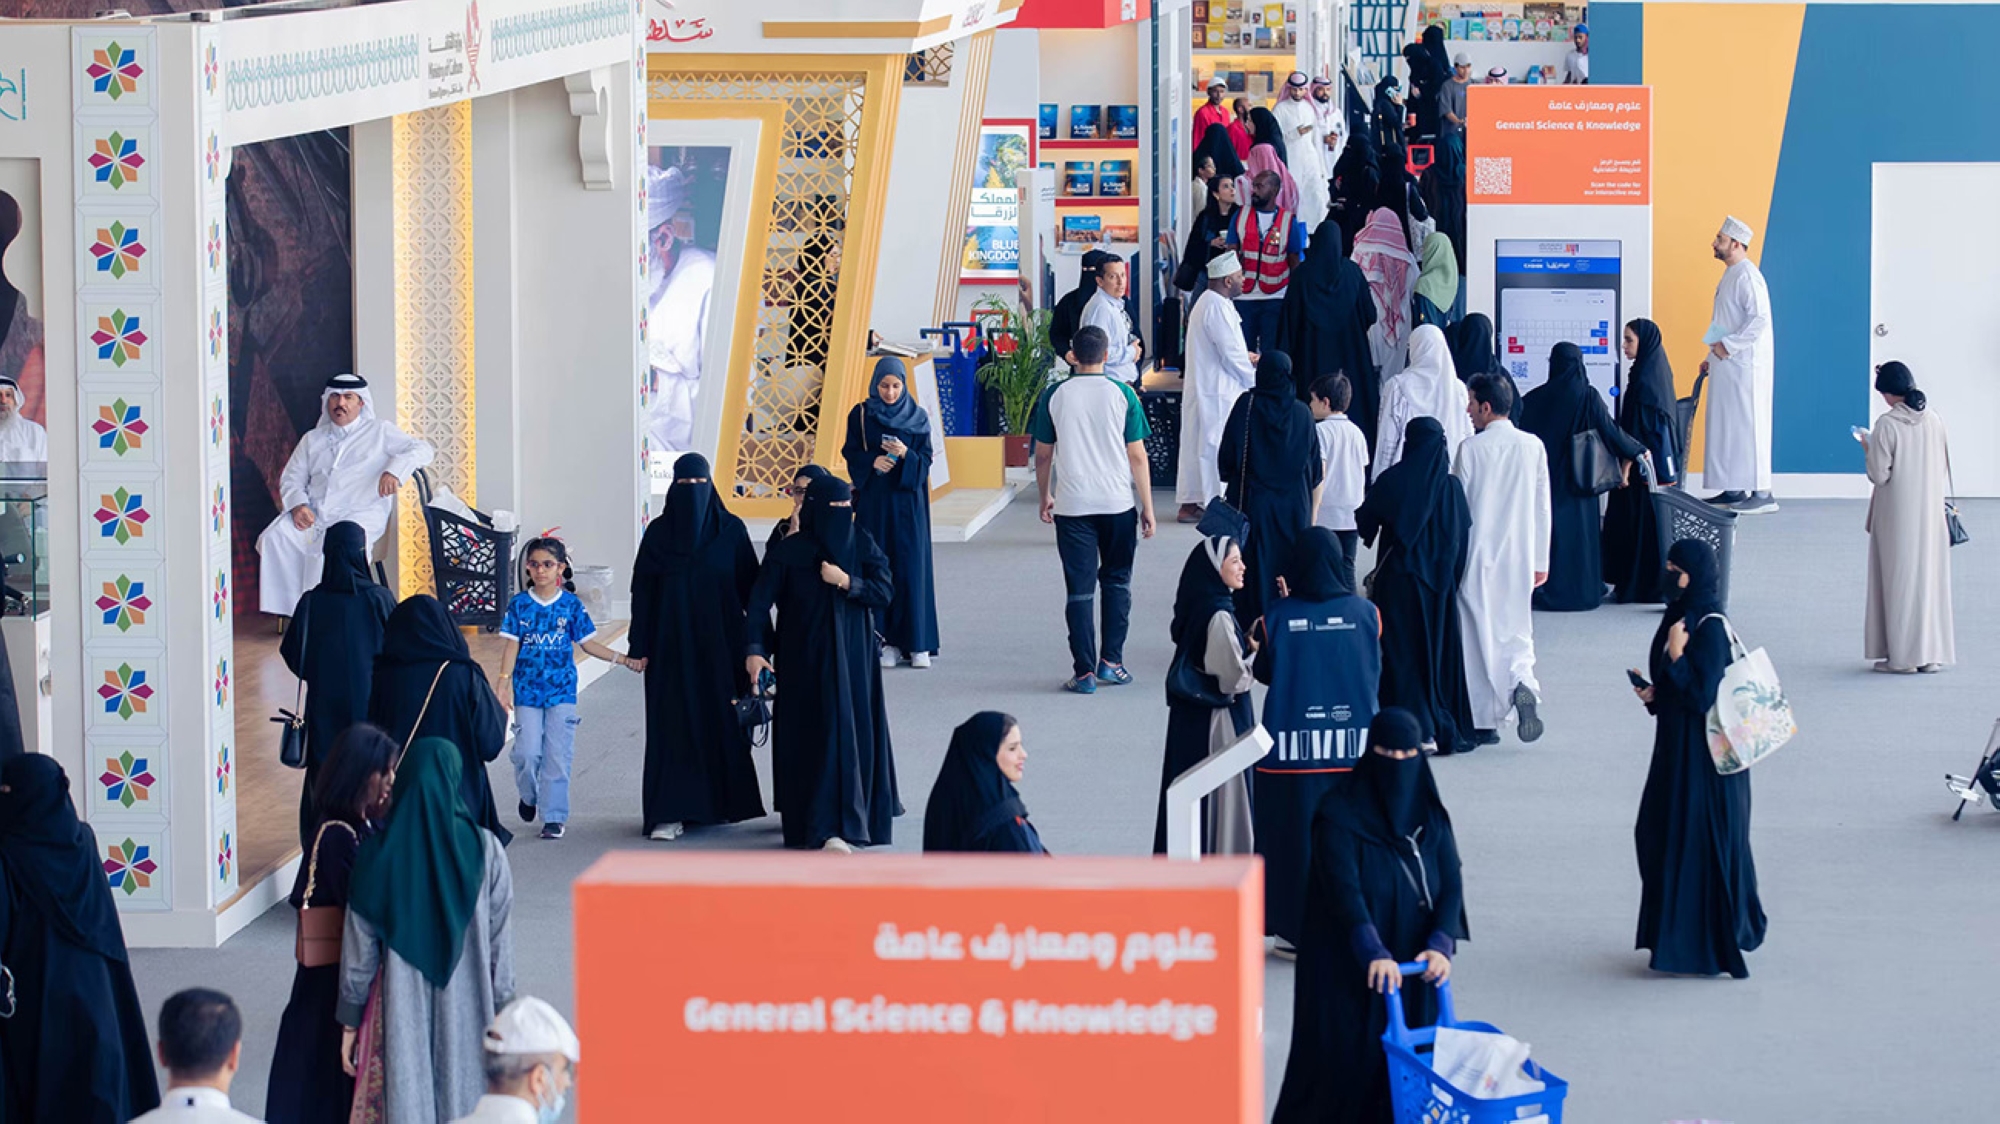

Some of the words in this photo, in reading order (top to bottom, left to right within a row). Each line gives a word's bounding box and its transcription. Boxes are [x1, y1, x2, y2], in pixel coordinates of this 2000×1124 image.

[1548, 100, 1573, 111] عامة
[1574, 100, 1614, 113] ومعارف
[1616, 101, 1641, 114] علوم
[1496, 120, 1535, 130] General
[1536, 120, 1575, 130] Science
[1577, 121, 1584, 131] &
[1586, 121, 1641, 132] Knowledge
[992, 239, 1019, 250] BLUE
[968, 251, 1019, 261] KINGDOM
[523, 633, 564, 645] SAVVY
[873, 922, 966, 960] عامة
[970, 923, 1117, 970] ومعارف
[1121, 926, 1217, 973] علوم
[683, 996, 827, 1032] General
[831, 995, 972, 1032] Science
[979, 998, 1007, 1037] &
[1012, 998, 1218, 1041] Knowledge
